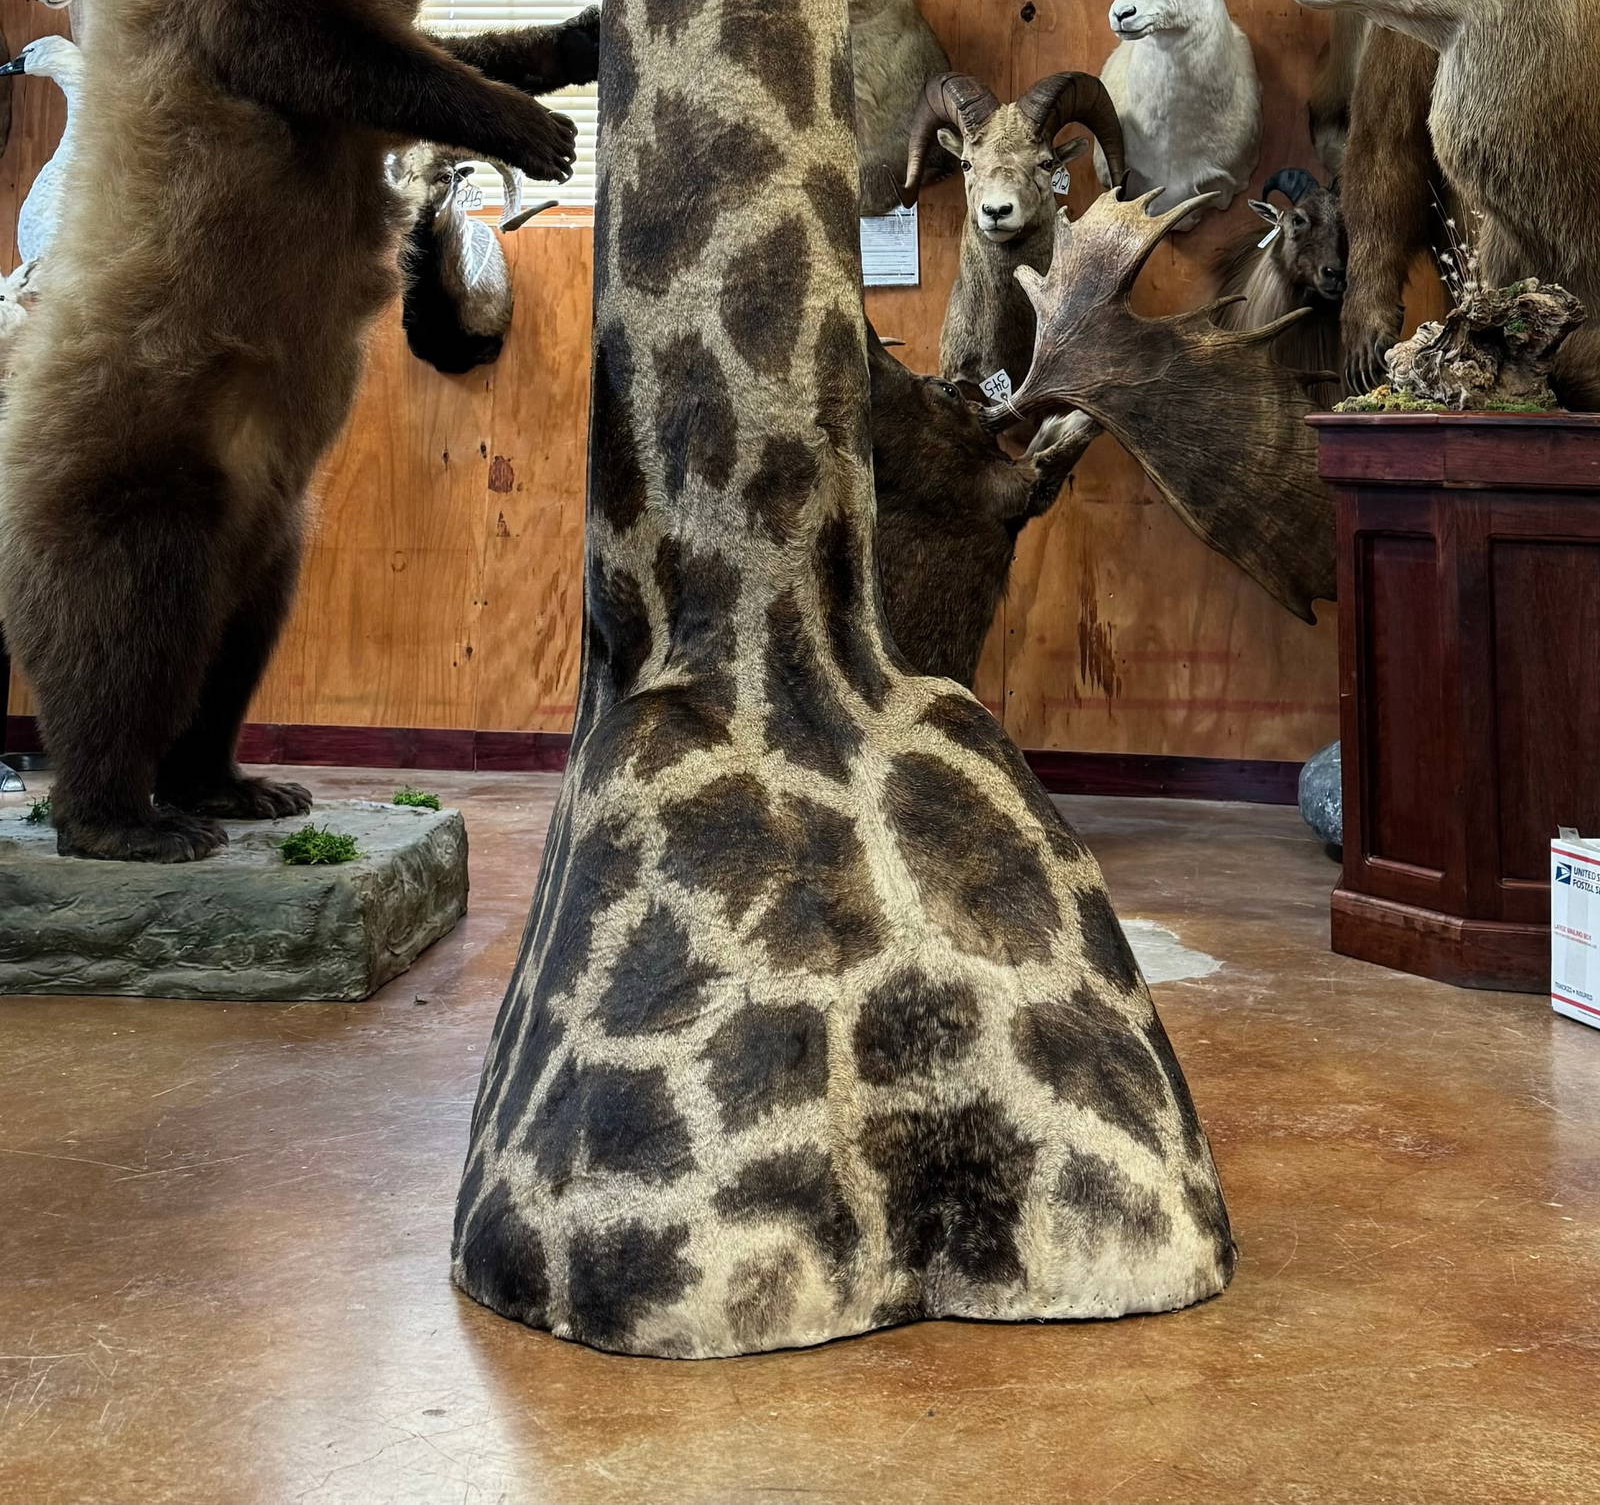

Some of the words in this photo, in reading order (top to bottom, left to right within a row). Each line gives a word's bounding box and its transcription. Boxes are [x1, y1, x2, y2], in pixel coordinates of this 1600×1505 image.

[1052, 170, 1070, 190] 212
[984, 373, 1009, 397] 345
[1573, 866, 1596, 881] UNITED
[1572, 878, 1594, 893] POSTAL
